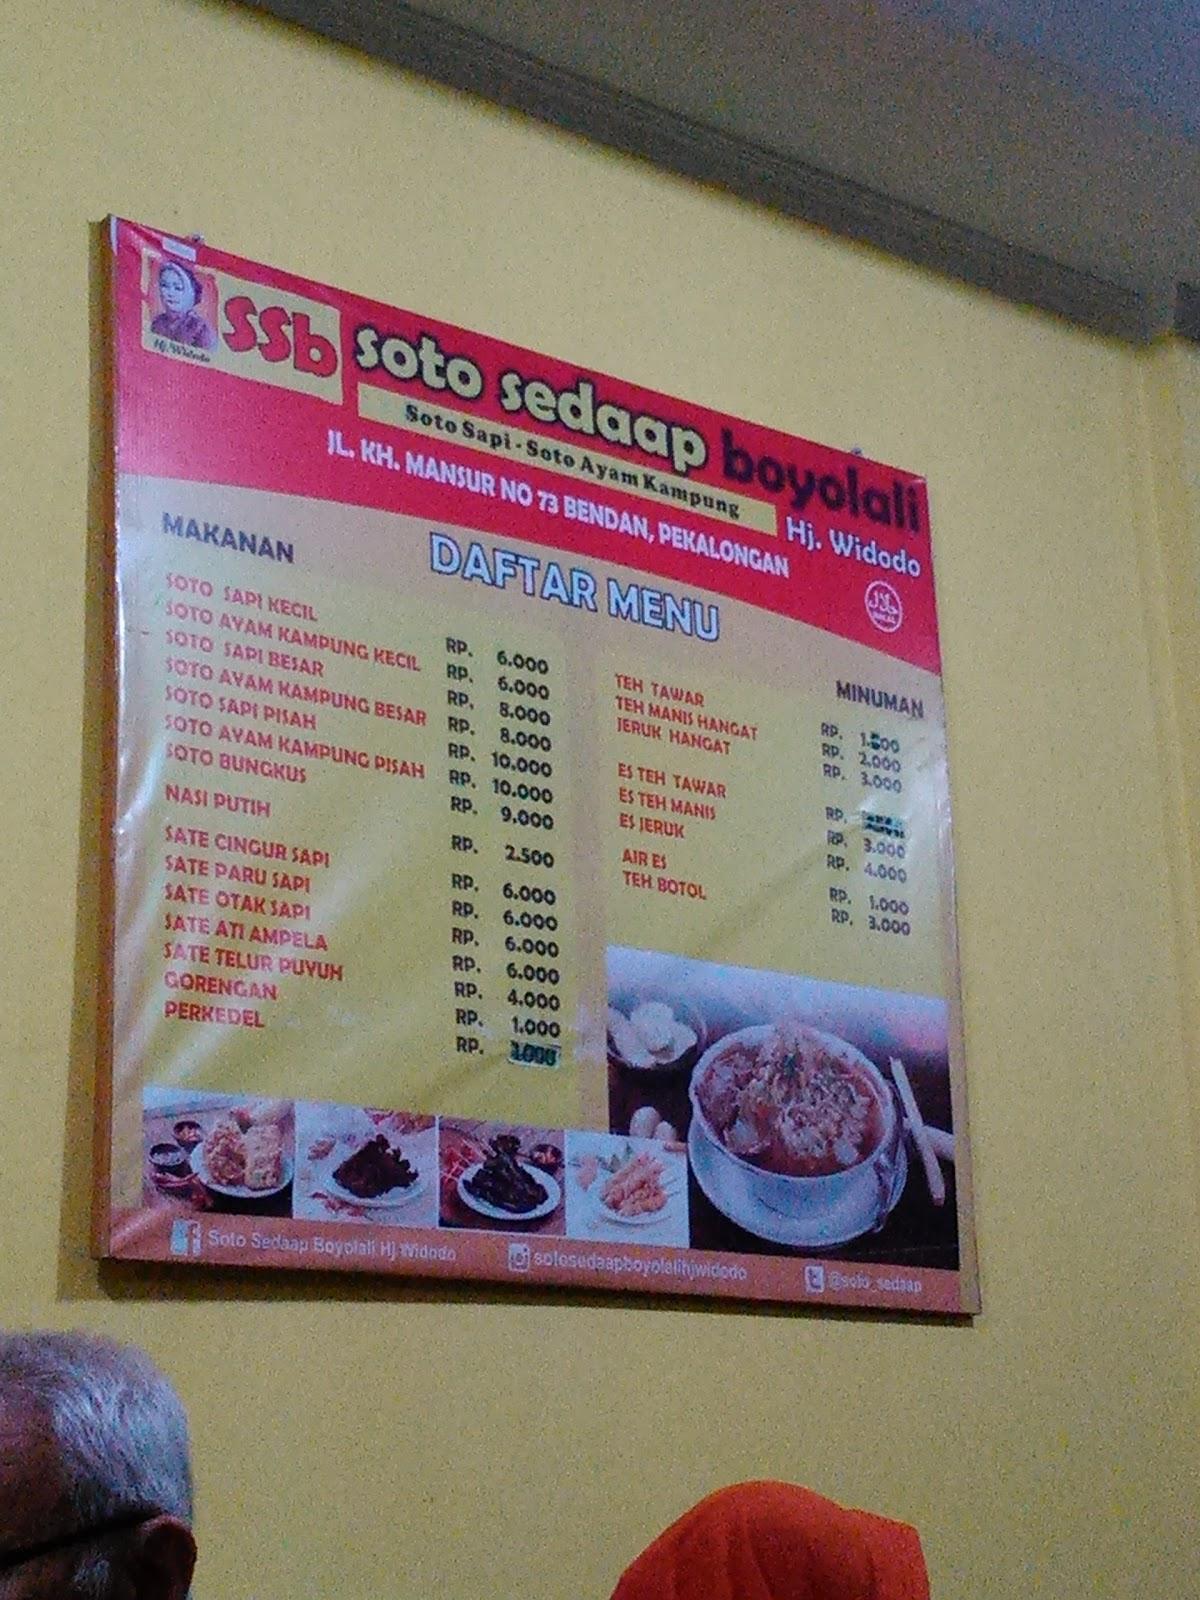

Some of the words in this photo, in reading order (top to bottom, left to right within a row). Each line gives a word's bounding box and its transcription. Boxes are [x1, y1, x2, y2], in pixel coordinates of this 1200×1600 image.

[354, 325, 484, 401] soto
[500, 369, 708, 474] sedaap
[721, 427, 921, 533] boyolali
[405, 404, 458, 434] Soto
[462, 419, 512, 450] Sapi
[527, 440, 575, 467] Soto
[579, 456, 638, 487] Ayam
[643, 474, 740, 519] Kampung
[327, 429, 355, 458] JL.
[360, 438, 400, 471] KH.
[405, 451, 496, 497] MANSUR
[500, 477, 533, 507] NO
[537, 490, 559, 514] 73
[564, 495, 655, 544] BENDAN,
[658, 521, 789, 578] PEKALONGAN
[162, 512, 294, 563] MAKANAN
[785, 516, 822, 553] Hj.
[829, 531, 921, 578] Widodo
[167, 572, 213, 597] SOTO
[224, 586, 262, 609] SAPI
[268, 596, 318, 621] KECIL
[430, 532, 598, 612] DAFTAR
[607, 578, 719, 641] MENU
[167, 602, 213, 624] SOTO
[219, 613, 273, 638] AYAM
[278, 627, 369, 660] KAMPUNG
[374, 648, 421, 671] KECIL
[166, 629, 213, 652] SOTO
[224, 642, 262, 664] SAPI
[268, 651, 324, 677] BESAR
[497, 650, 549, 675] 6.000
[165, 656, 213, 680] SOTO
[219, 669, 273, 694] AYAM
[279, 681, 370, 714] KAMPUNG
[375, 702, 427, 726] BESAR
[498, 676, 550, 700] 6.000
[615, 673, 643, 693] TEH
[651, 682, 704, 707] TAWAR
[836, 681, 924, 718] MINUMAN
[165, 685, 213, 709] SOTO
[219, 697, 258, 719] SAPI
[264, 705, 317, 730] PISAH
[499, 702, 551, 726] 8.000
[615, 696, 644, 714] TEH
[649, 703, 693, 726] MANIS
[697, 715, 758, 741] HANGAT
[165, 714, 212, 737] SOTO
[219, 725, 273, 749] AYAM
[279, 737, 370, 769] KAMPUNG
[374, 755, 425, 779] PISAH
[500, 727, 552, 752] 8.000
[617, 717, 661, 740] JERUK
[670, 730, 730, 755] HANGAT
[165, 743, 213, 766] SOTO
[220, 752, 306, 783] BUNGKUS
[492, 751, 552, 777] 10.000
[859, 752, 901, 772] 2.000
[492, 778, 553, 804] 10.000
[618, 762, 632, 779] ES
[637, 767, 665, 785] TEH
[673, 774, 726, 799] TAWAR
[861, 772, 902, 793] 3.000
[165, 784, 207, 807] NASI
[214, 792, 271, 818] PUTIH
[619, 787, 634, 804] ES
[637, 792, 666, 810] TEH
[671, 798, 716, 820] MANIS
[501, 806, 554, 830] 9.000
[620, 813, 635, 829] ES
[640, 817, 684, 838] JERUK
[165, 825, 209, 848] SATE
[215, 833, 287, 861] CINGUR
[292, 847, 330, 868] SAPI
[505, 845, 555, 868] 2.500
[622, 848, 648, 866] AIR
[652, 852, 667, 869] ES
[863, 838, 906, 859] 3.000
[165, 854, 209, 876] SATE
[215, 862, 267, 885] PARU
[272, 872, 310, 894] SAPI
[623, 871, 652, 889] TEH
[657, 876, 707, 899] BOTOL
[864, 862, 907, 883] 4.000
[165, 882, 209, 905] SATE
[216, 891, 266, 915] OTAK
[271, 899, 310, 921] SAPI
[503, 882, 556, 906] 6.000
[869, 895, 909, 915] 1.000
[164, 912, 209, 934] SATE
[215, 920, 244, 940] ATI
[248, 925, 328, 951] AMPELA
[503, 910, 558, 931] 6.000
[868, 916, 910, 935] 3.000
[505, 936, 559, 958] 6.000
[164, 942, 209, 964] SATE
[215, 948, 273, 972] TELUR
[279, 957, 343, 982] PUYUH
[506, 963, 560, 985] 6.000
[164, 971, 277, 1000] GORENGAN
[507, 989, 560, 1011] 4.000
[164, 1001, 265, 1029] PERKEDEL
[512, 1016, 560, 1038] 1.000
[207, 1229, 247, 1249] Soto
[251, 1233, 308, 1254] Sedaap
[314, 1236, 375, 1258] Boyolali
